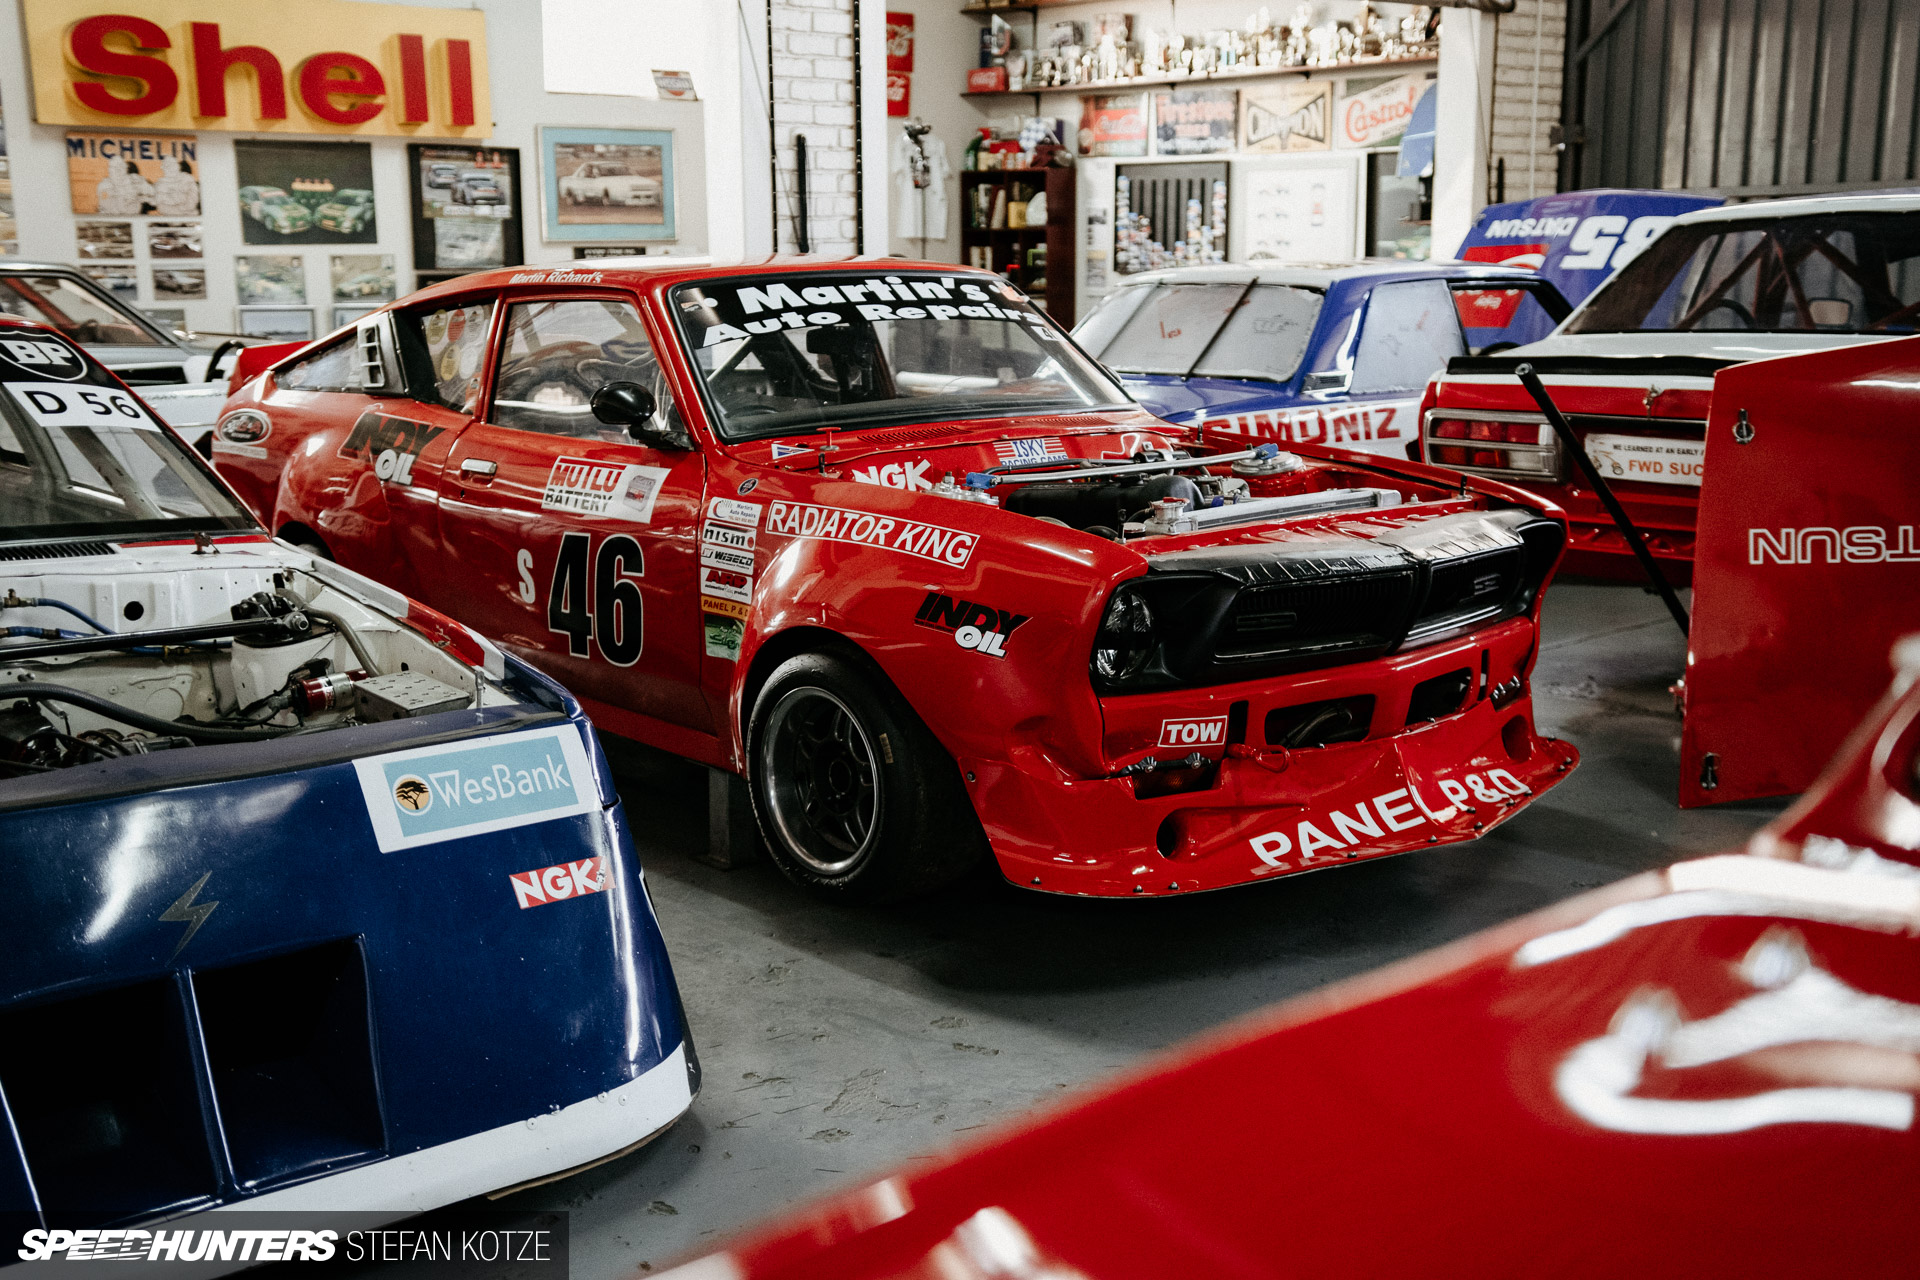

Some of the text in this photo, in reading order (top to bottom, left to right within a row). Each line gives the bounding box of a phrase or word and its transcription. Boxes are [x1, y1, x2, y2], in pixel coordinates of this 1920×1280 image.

[67, 14, 476, 127] Shell
[1346, 86, 1417, 142] Castrol
[65, 138, 197, 161] MICHELIN
[1484, 216, 1579, 239] DATSUN
[509, 270, 604, 284] Martin Richard's
[736, 276, 990, 315] Martin's
[703, 302, 1045, 347] Auto Repairs
[1, 340, 73, 366] BP
[23, 390, 141, 419] D 56
[343, 411, 447, 460] INDY
[1203, 407, 1400, 445] SIMONIZ
[1012, 439, 1046, 458] ISKY
[1624, 444, 1653, 453] LEARNED
[1677, 448, 1699, 456] EARLY
[375, 448, 416, 486] OIL
[550, 463, 622, 493] MUTLU
[852, 459, 934, 492] NGK
[1628, 459, 1664, 473] FWD
[545, 488, 613, 513] BATTERY
[768, 503, 973, 564] RADIATOR KING
[705, 569, 748, 589] ARP
[517, 531, 645, 667] S 46
[703, 599, 729, 611] PANEL
[731, 605, 737, 613] P
[738, 607, 744, 616] &
[915, 591, 1030, 642] INDY
[955, 625, 1007, 658] OIL
[1166, 722, 1223, 743] TOW
[428, 754, 571, 808] WesBank
[1249, 768, 1531, 867] PANEL P&D
[510, 858, 602, 909] NGK
